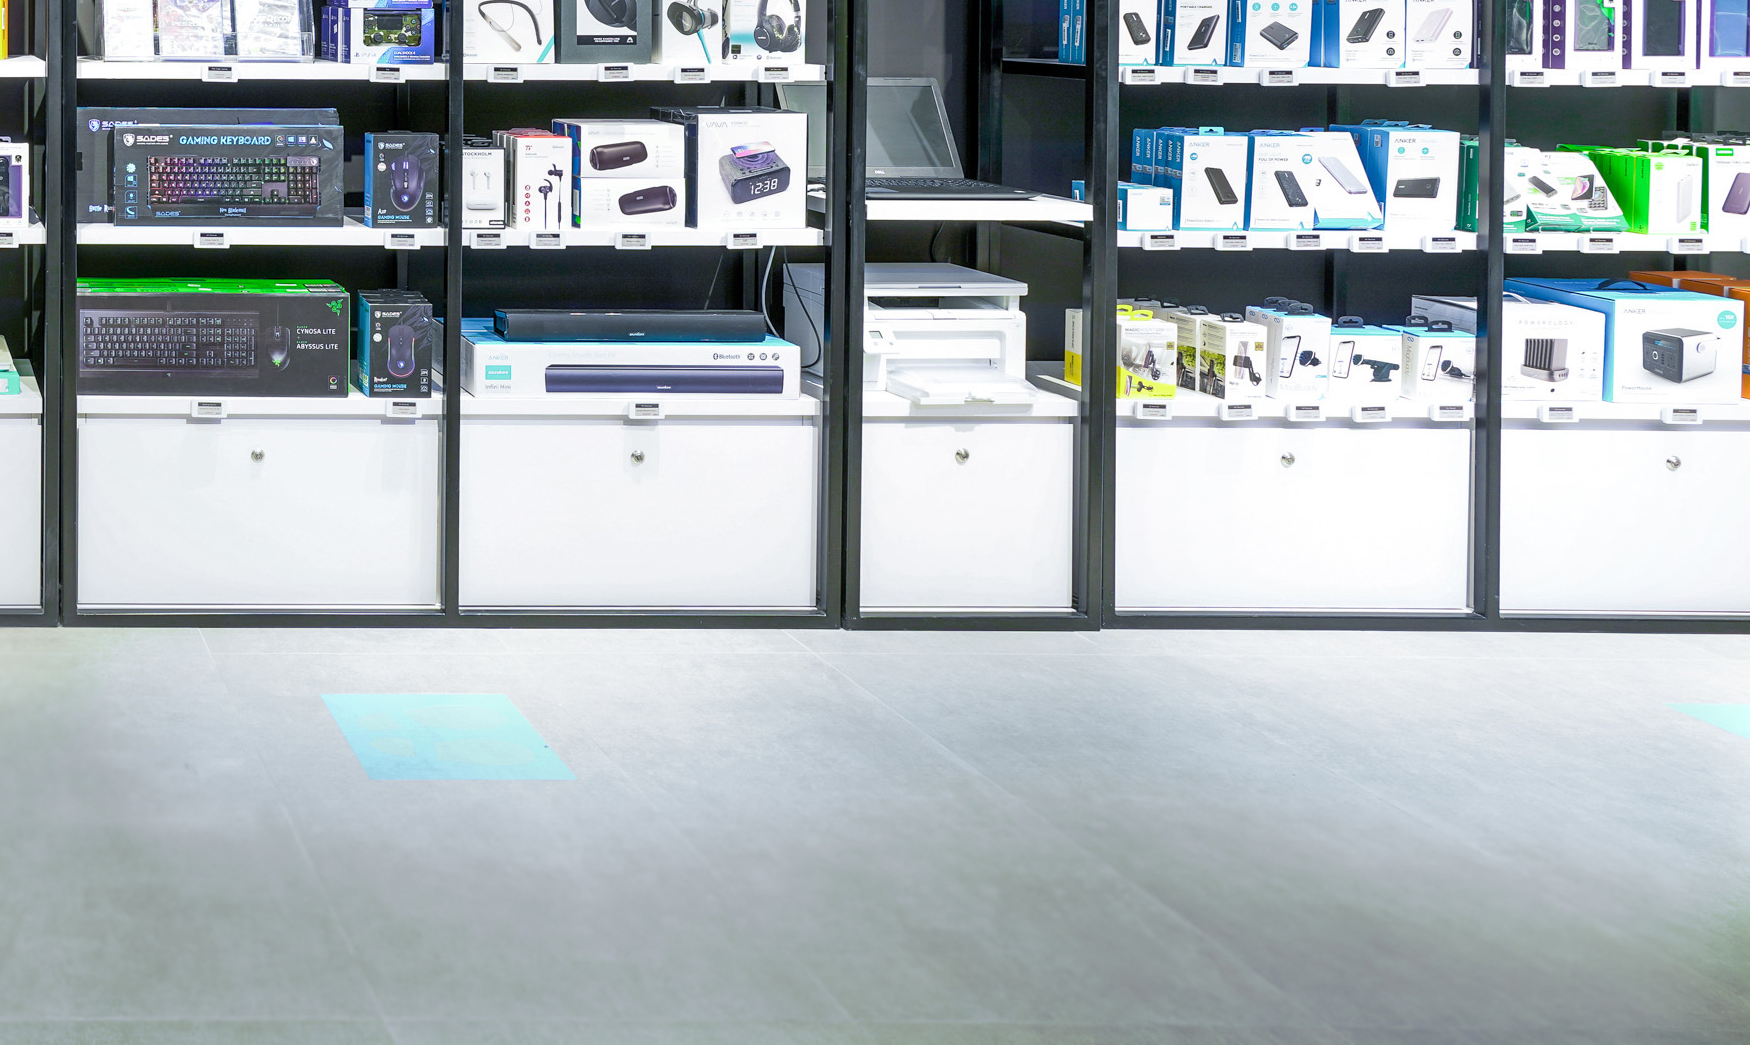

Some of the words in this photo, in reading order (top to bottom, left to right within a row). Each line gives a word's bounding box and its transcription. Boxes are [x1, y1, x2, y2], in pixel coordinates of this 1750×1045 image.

[136, 135, 170, 143] SADES
[179, 135, 218, 146] GAMING
[220, 135, 271, 146] KEYBOARD
[750, 178, 778, 195] 12:38
